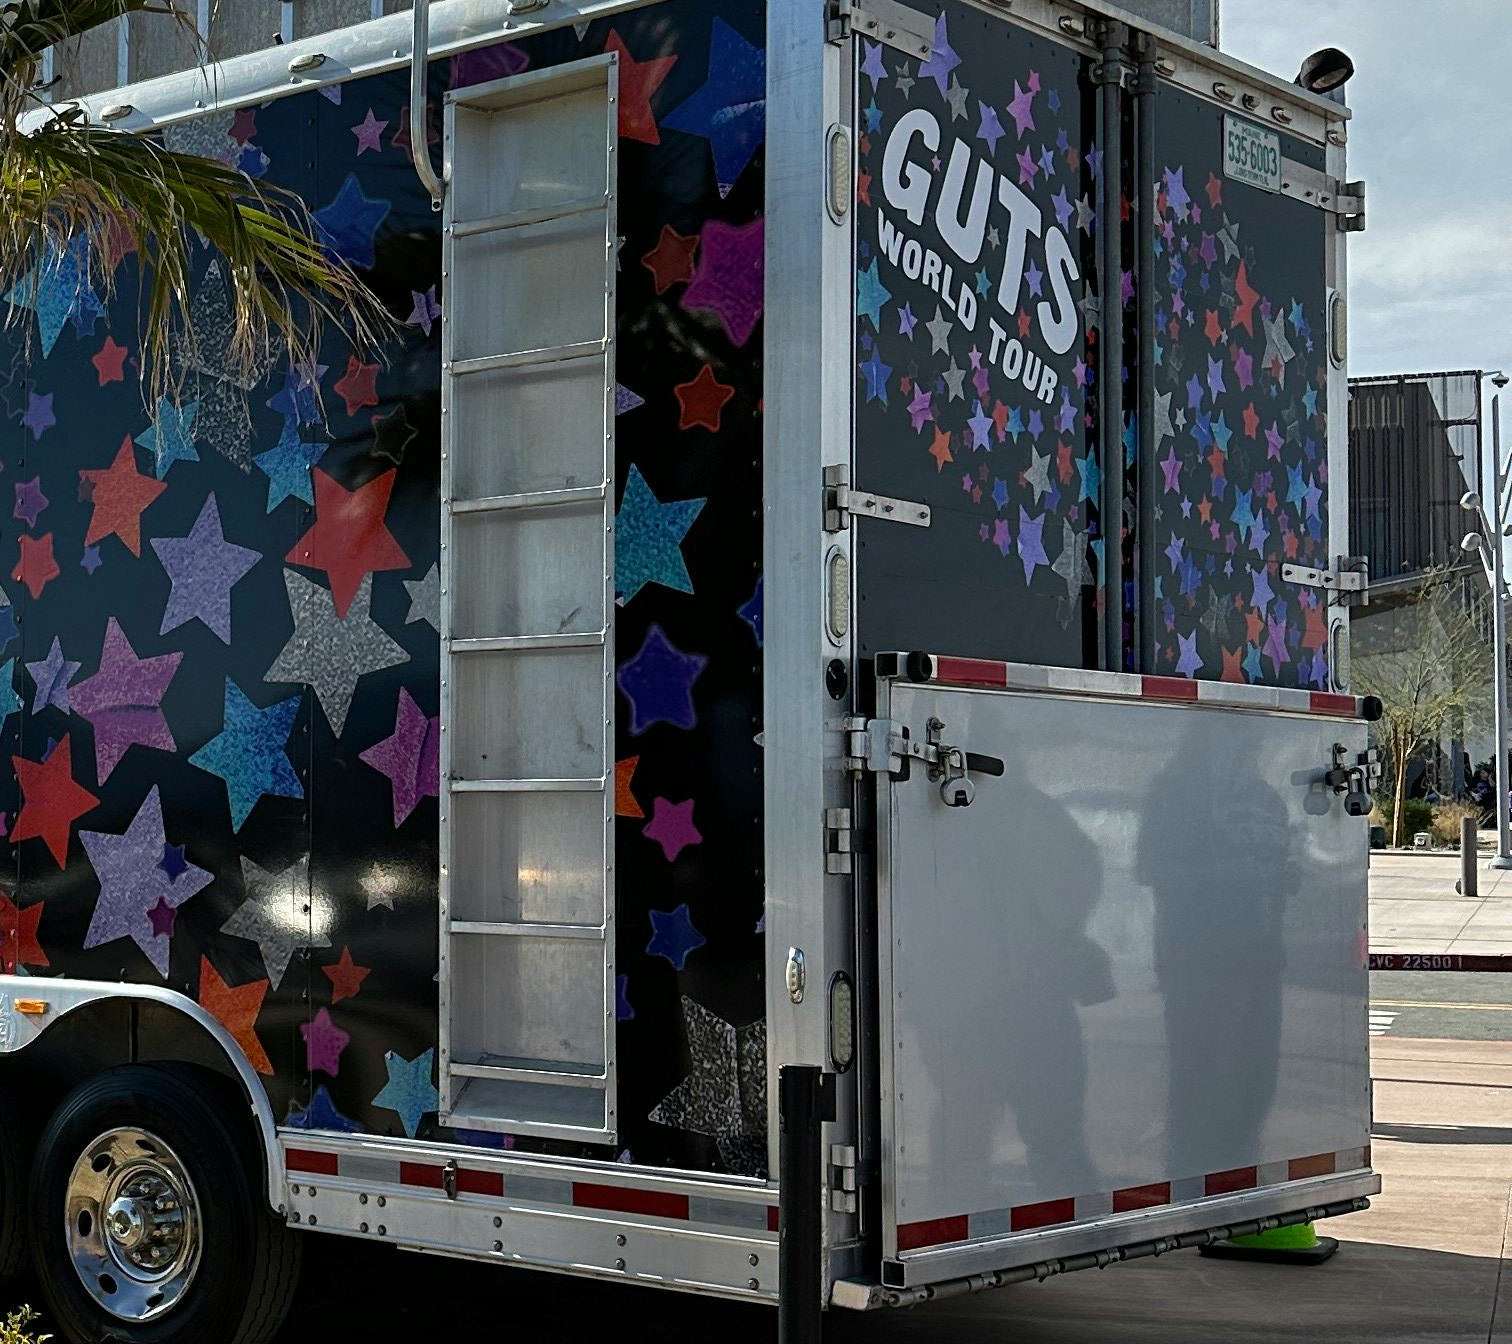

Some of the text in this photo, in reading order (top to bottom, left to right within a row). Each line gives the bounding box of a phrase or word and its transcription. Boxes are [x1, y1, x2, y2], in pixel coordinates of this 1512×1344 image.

[881, 108, 1080, 354] GUTS
[1228, 130, 1278, 177] 535-6003
[876, 206, 1058, 405] WORLD TOUR
